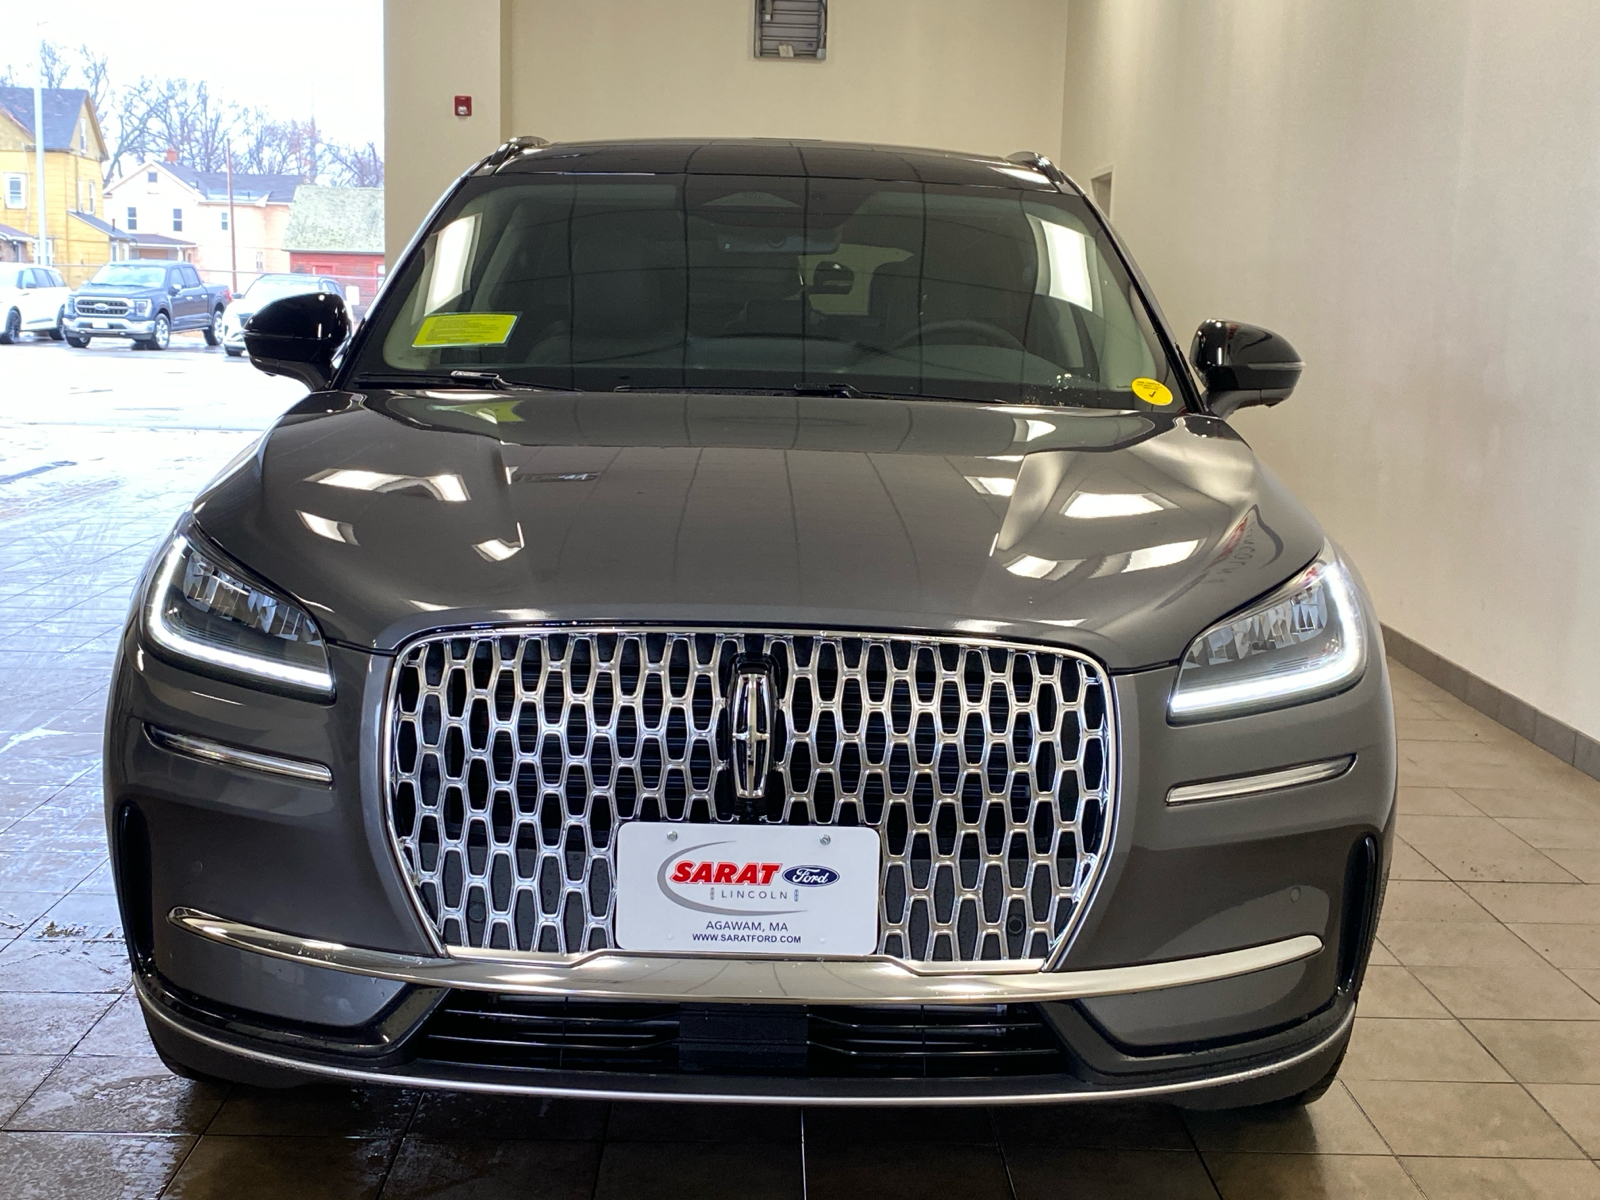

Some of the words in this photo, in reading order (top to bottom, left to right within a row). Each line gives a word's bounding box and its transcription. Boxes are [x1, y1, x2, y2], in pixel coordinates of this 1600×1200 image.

[670, 860, 783, 886] SARAT
[791, 868, 829, 884] Ford
[721, 890, 788, 899] LINCOLN
[706, 920, 765, 932] AGAWAM,
[769, 922, 788, 931] MA
[692, 933, 801, 943] WWW.SARATFORD.COM
